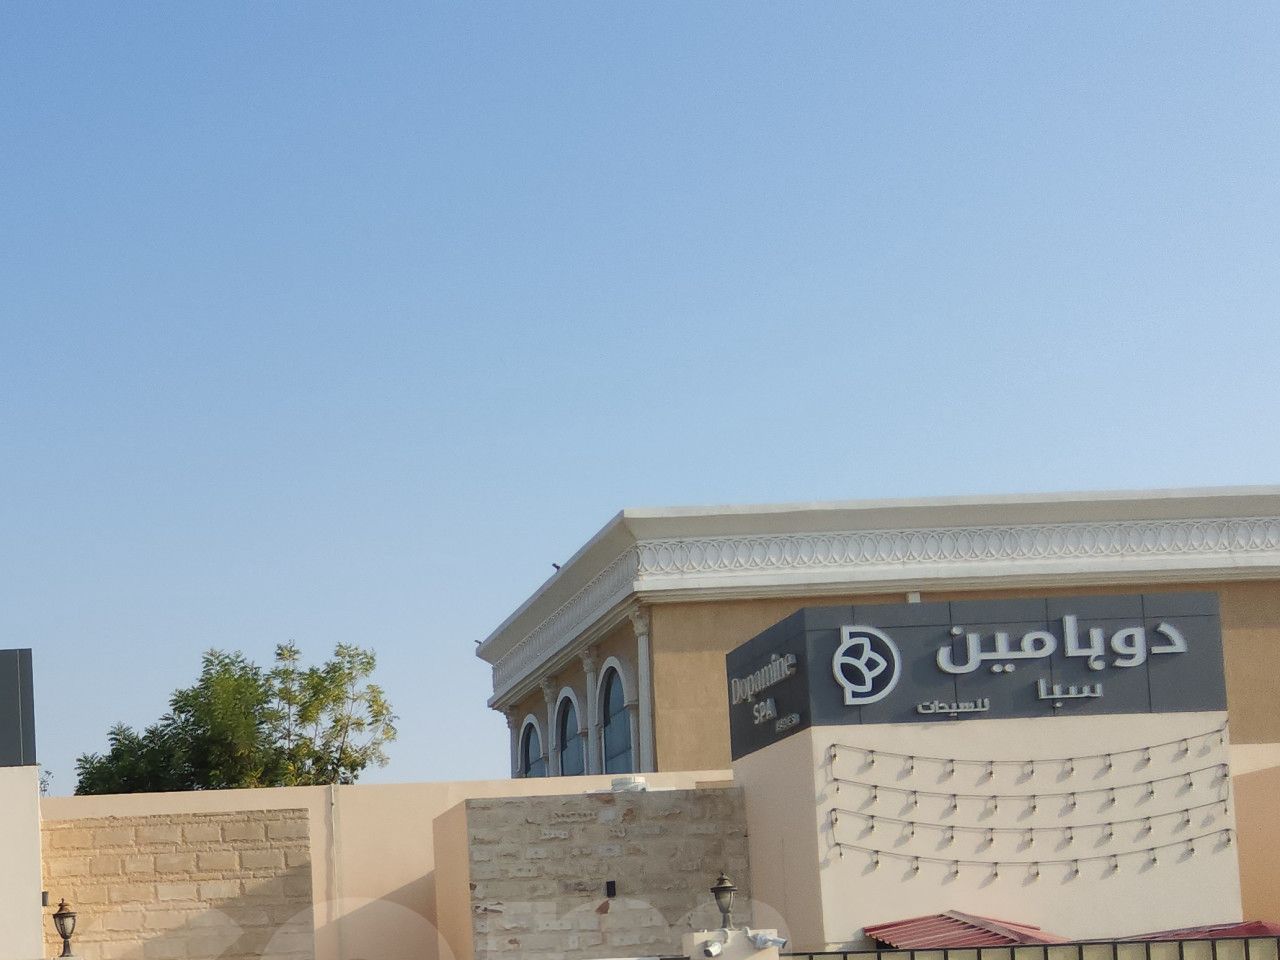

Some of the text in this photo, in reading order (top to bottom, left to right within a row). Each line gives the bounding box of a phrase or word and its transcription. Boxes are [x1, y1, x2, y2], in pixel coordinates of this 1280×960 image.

[936, 615, 1188, 674] دوبامين
[917, 698, 990, 717] للسيدات
[1037, 678, 1103, 709] سبا
